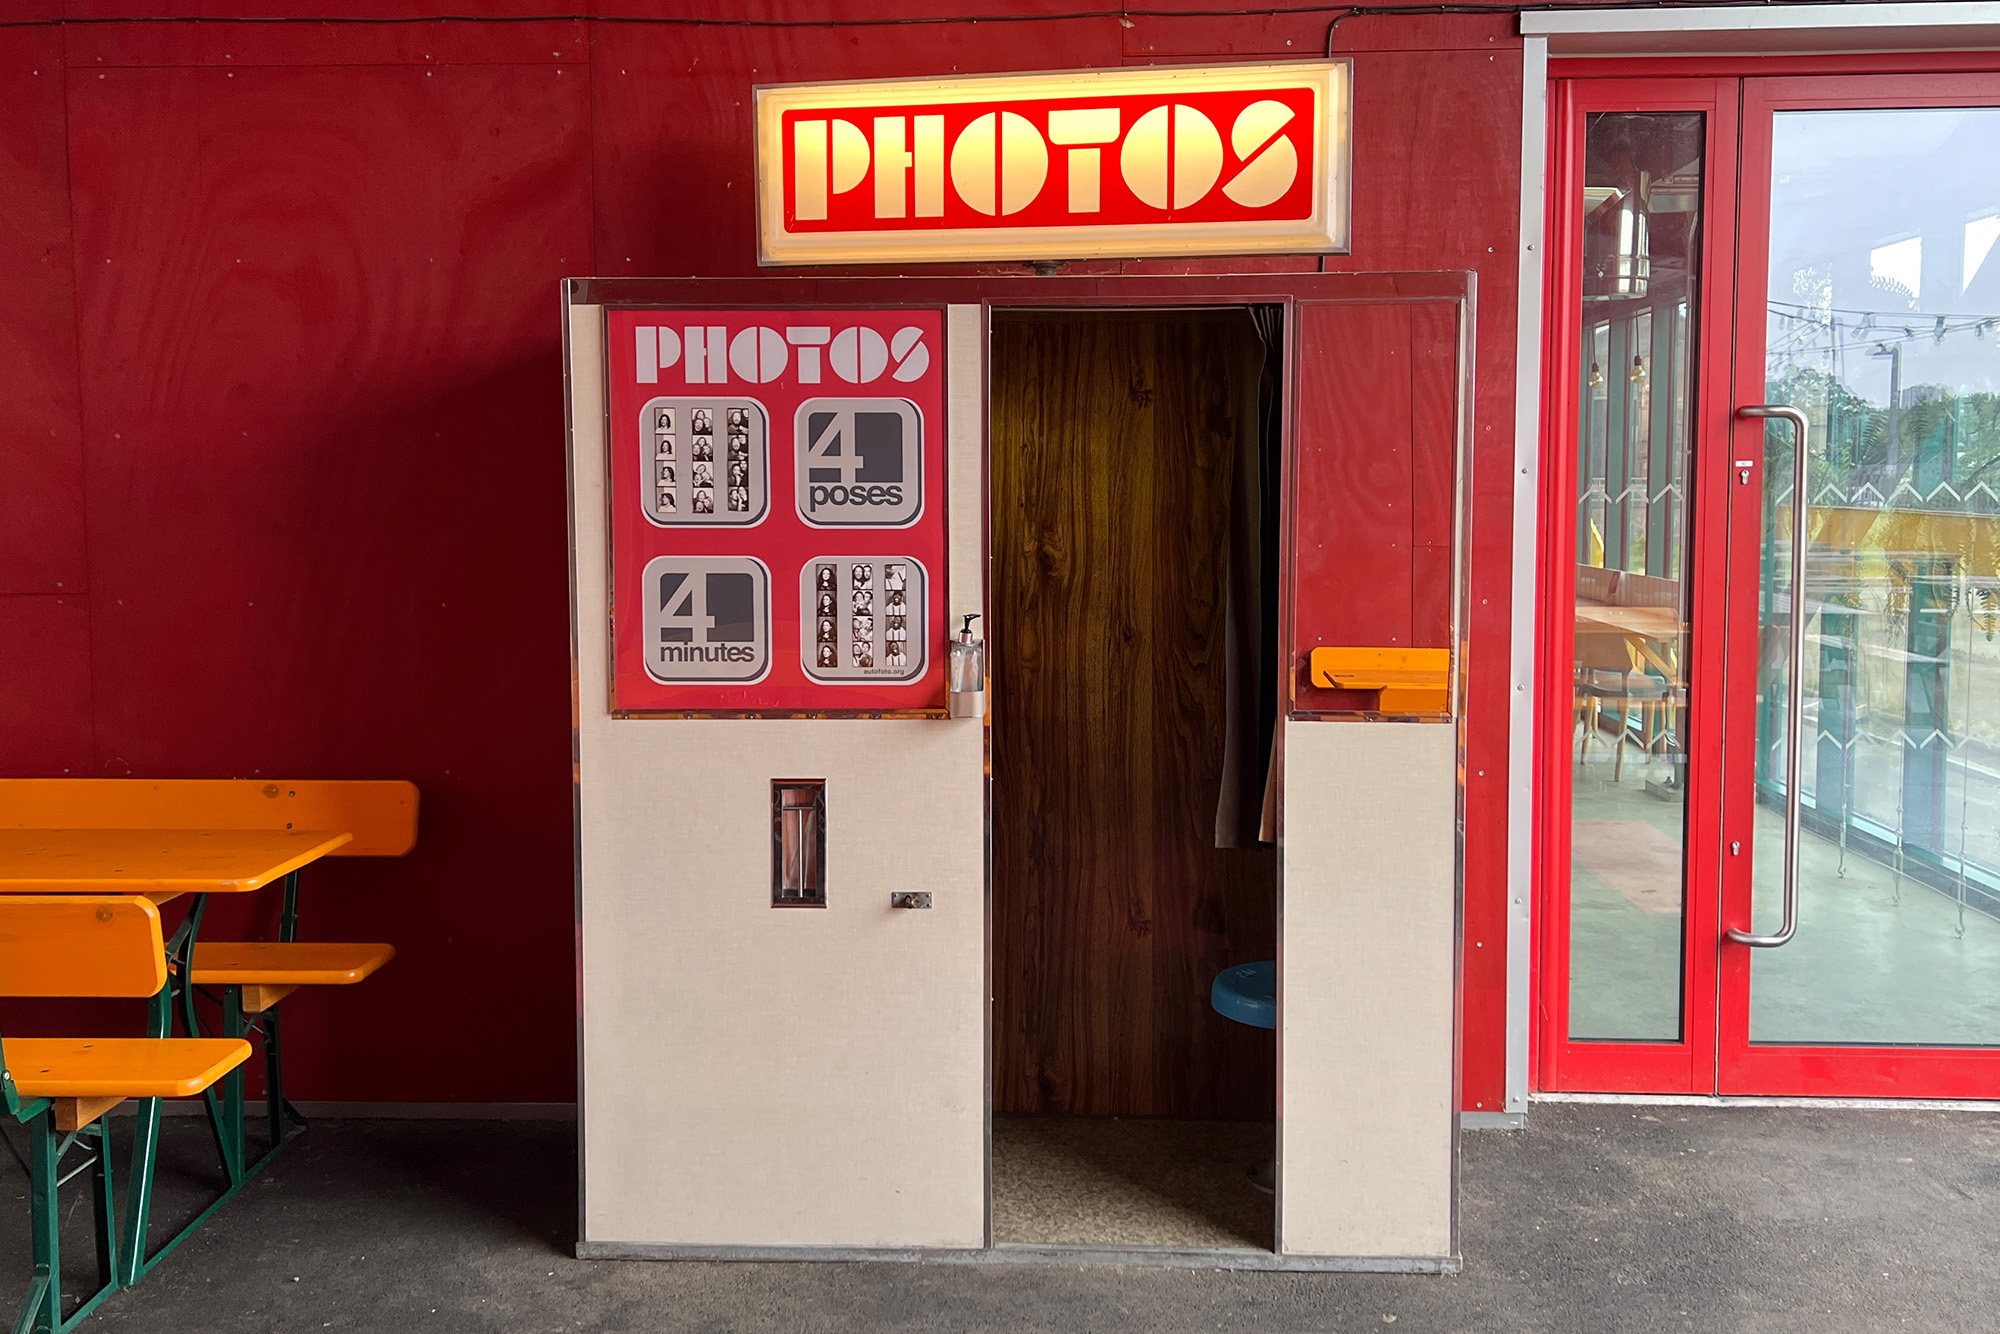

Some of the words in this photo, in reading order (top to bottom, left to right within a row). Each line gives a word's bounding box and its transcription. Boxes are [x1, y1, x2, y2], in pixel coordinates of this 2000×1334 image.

[794, 100, 1298, 221] PHOTOS
[635, 326, 930, 384] PHOTOS
[808, 411, 864, 483] 4
[809, 484, 903, 512] poses
[660, 573, 716, 642] 4
[660, 642, 755, 662] minutes
[863, 668, 905, 676] autofoto.org
